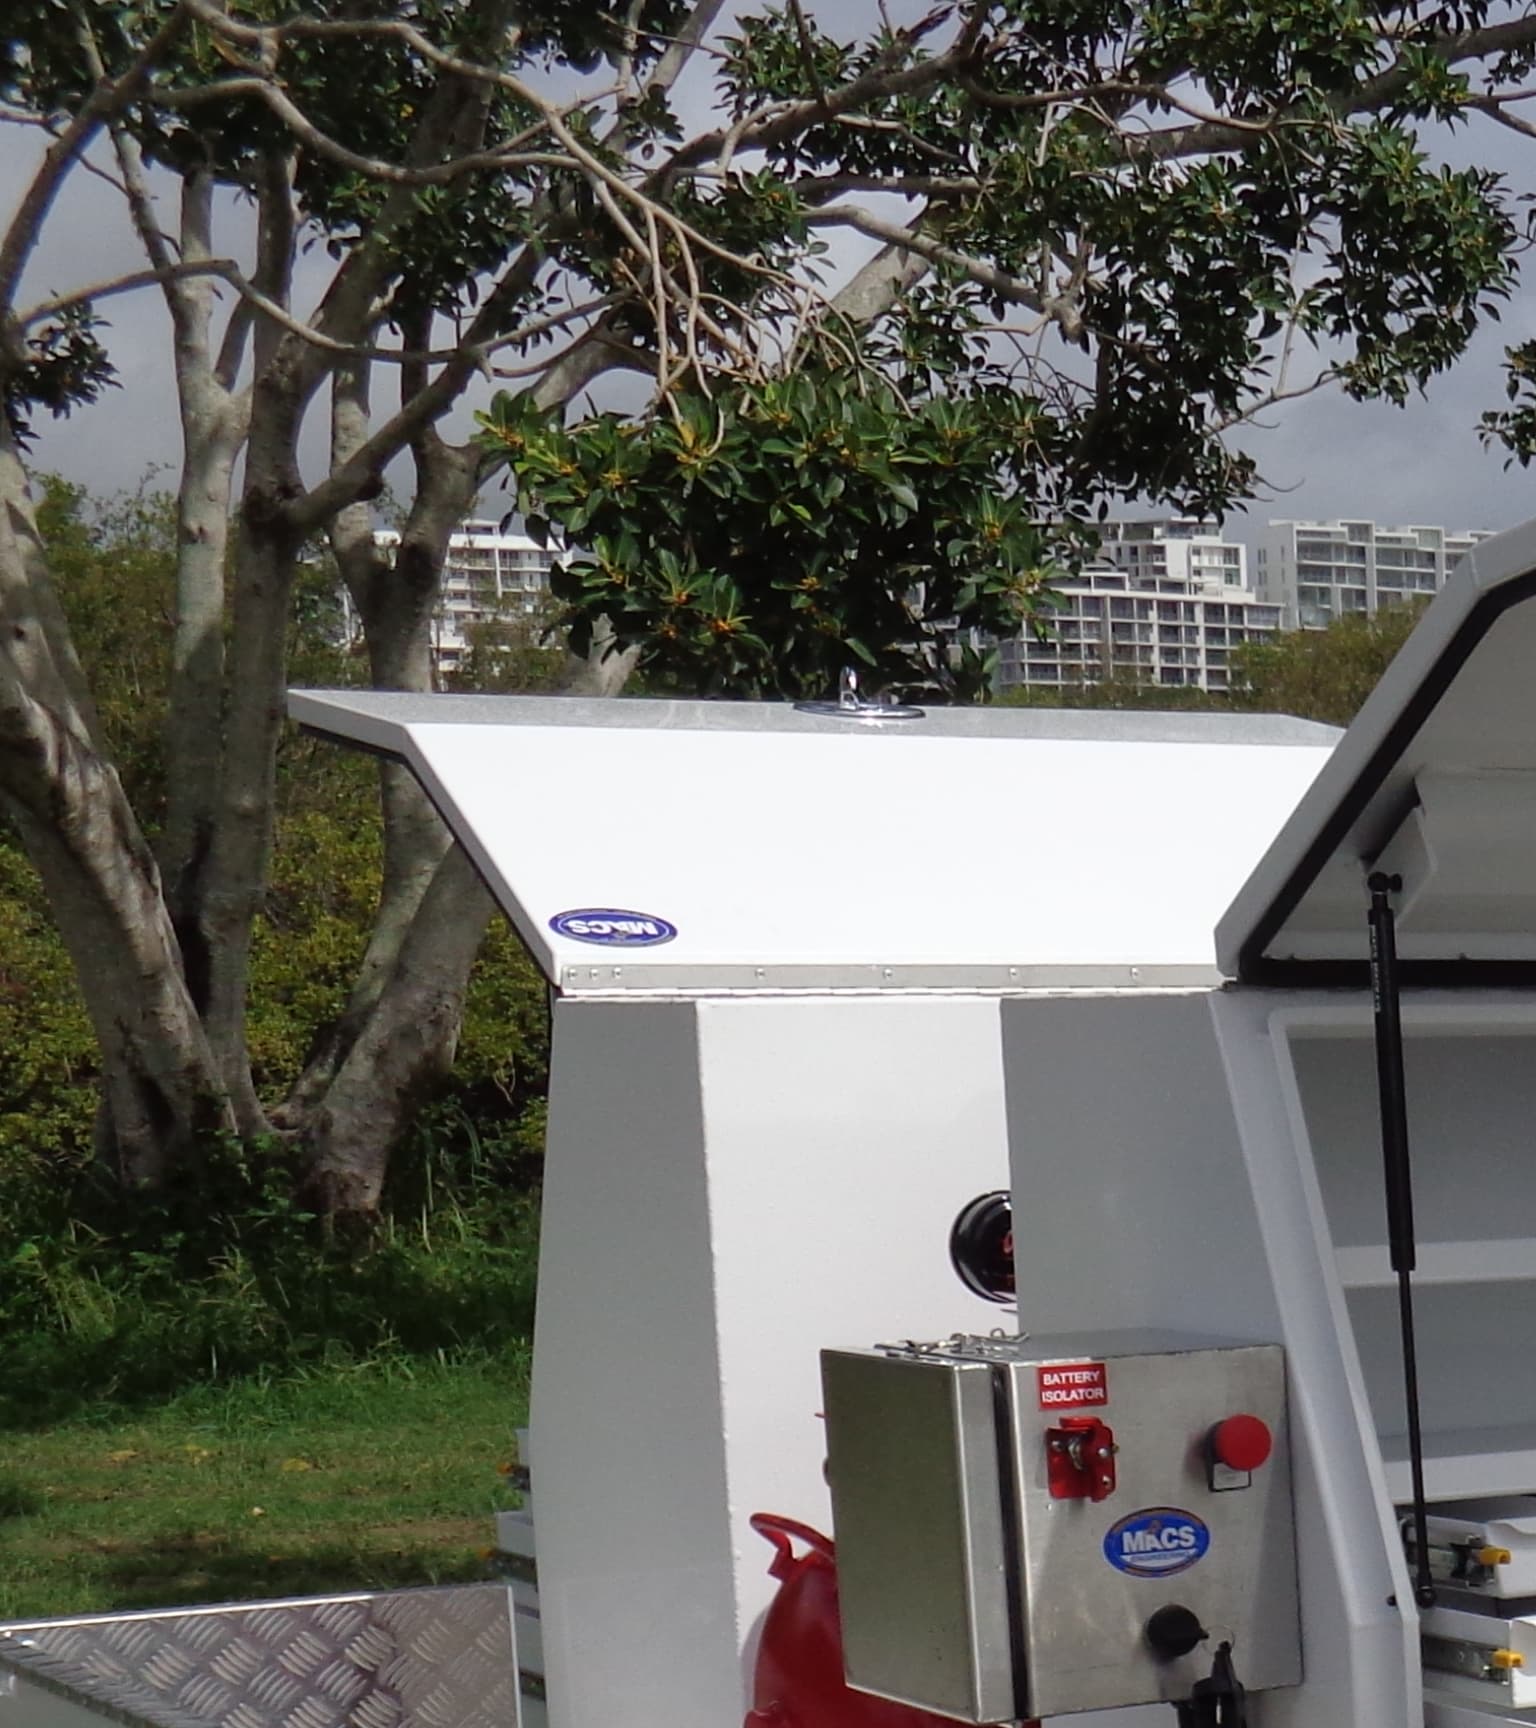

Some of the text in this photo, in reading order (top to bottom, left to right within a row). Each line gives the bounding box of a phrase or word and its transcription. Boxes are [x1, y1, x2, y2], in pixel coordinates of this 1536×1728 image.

[565, 919, 659, 935] MACS
[1043, 1370, 1100, 1386] BATTERY
[1041, 1387, 1105, 1404] ISOLATOR
[1122, 1525, 1196, 1553] MACS
